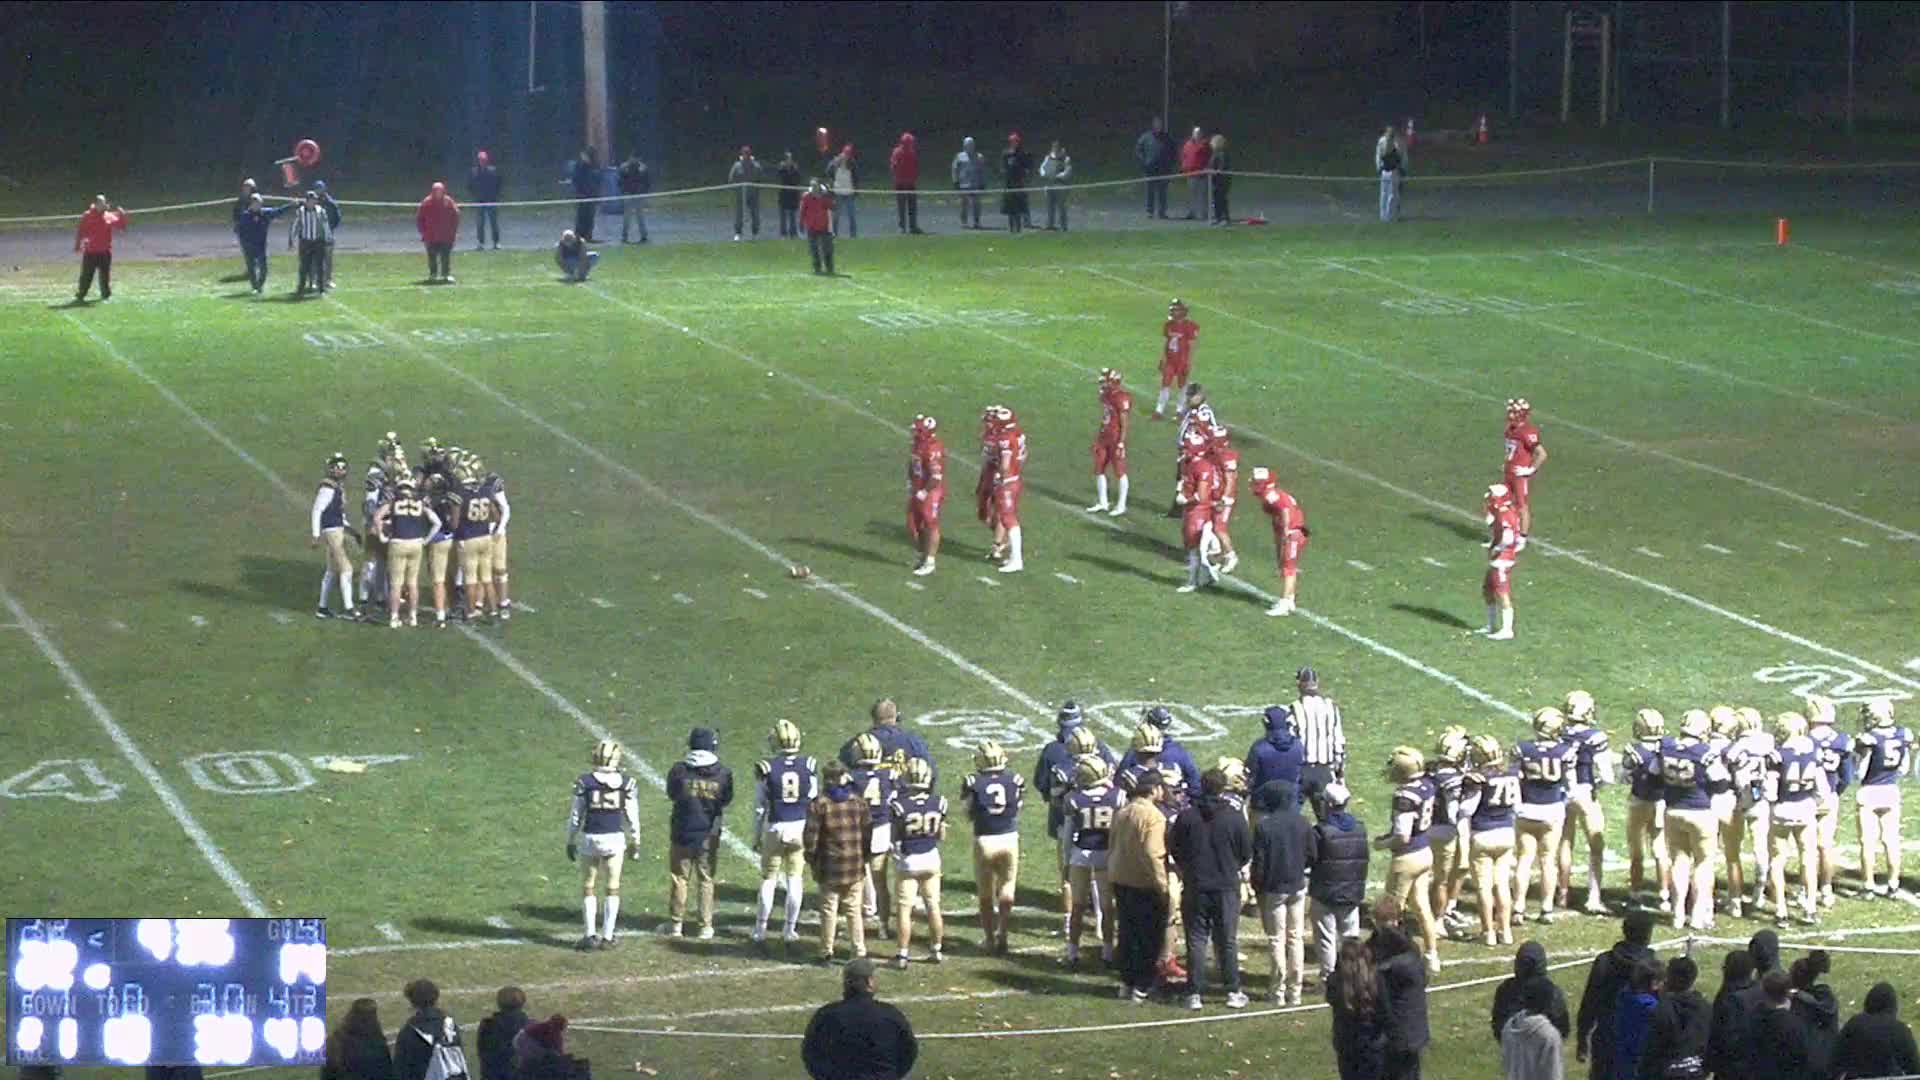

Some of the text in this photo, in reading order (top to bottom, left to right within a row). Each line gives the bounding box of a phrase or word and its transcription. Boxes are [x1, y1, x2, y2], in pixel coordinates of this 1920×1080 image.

[781, 771, 800, 803] 8
[864, 776, 880, 806] 4
[986, 783, 1007, 815] 3
[1488, 776, 1521, 806] 78
